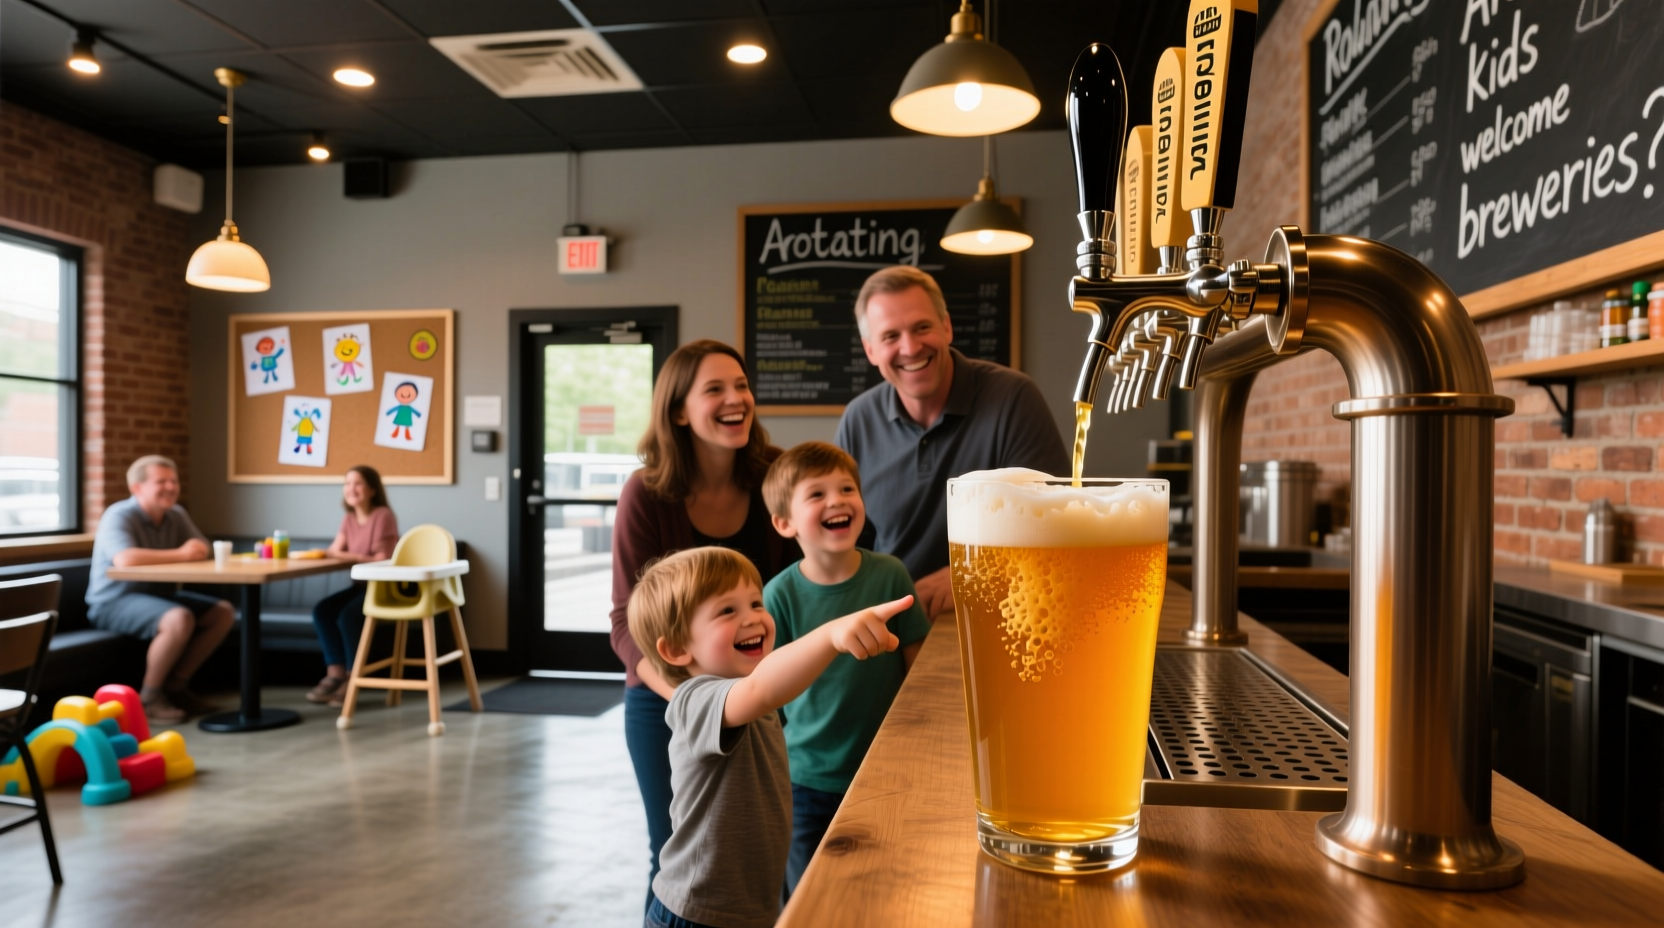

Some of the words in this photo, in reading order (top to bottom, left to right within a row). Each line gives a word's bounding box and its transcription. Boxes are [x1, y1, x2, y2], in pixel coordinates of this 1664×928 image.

[1466, 9, 1539, 113] kids
[1457, 86, 1664, 259] breweries?
[1460, 83, 1570, 174] welcome
